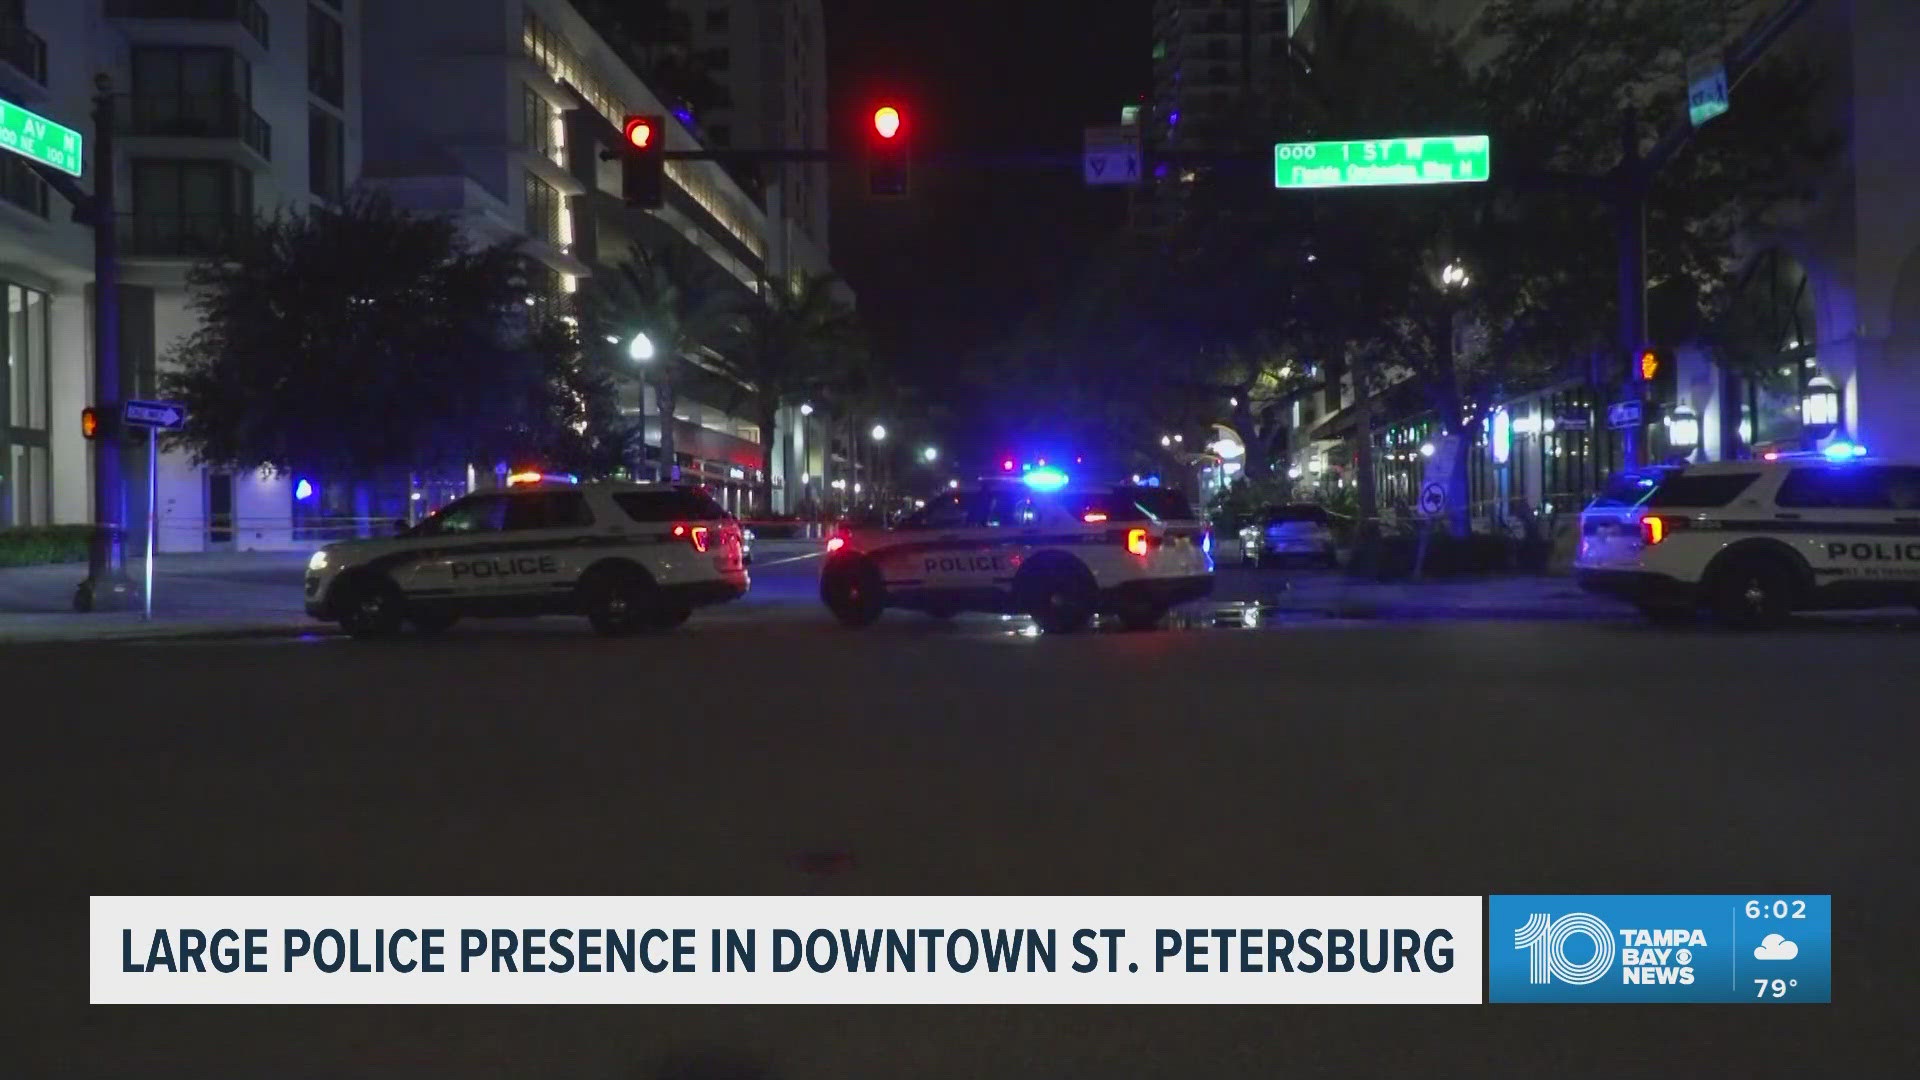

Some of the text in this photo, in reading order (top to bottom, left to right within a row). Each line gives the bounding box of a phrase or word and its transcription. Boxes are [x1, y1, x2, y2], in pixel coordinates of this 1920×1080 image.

[1364, 141, 1392, 160] ST
[450, 554, 558, 578] POLICE
[924, 556, 1006, 574] POLICE
